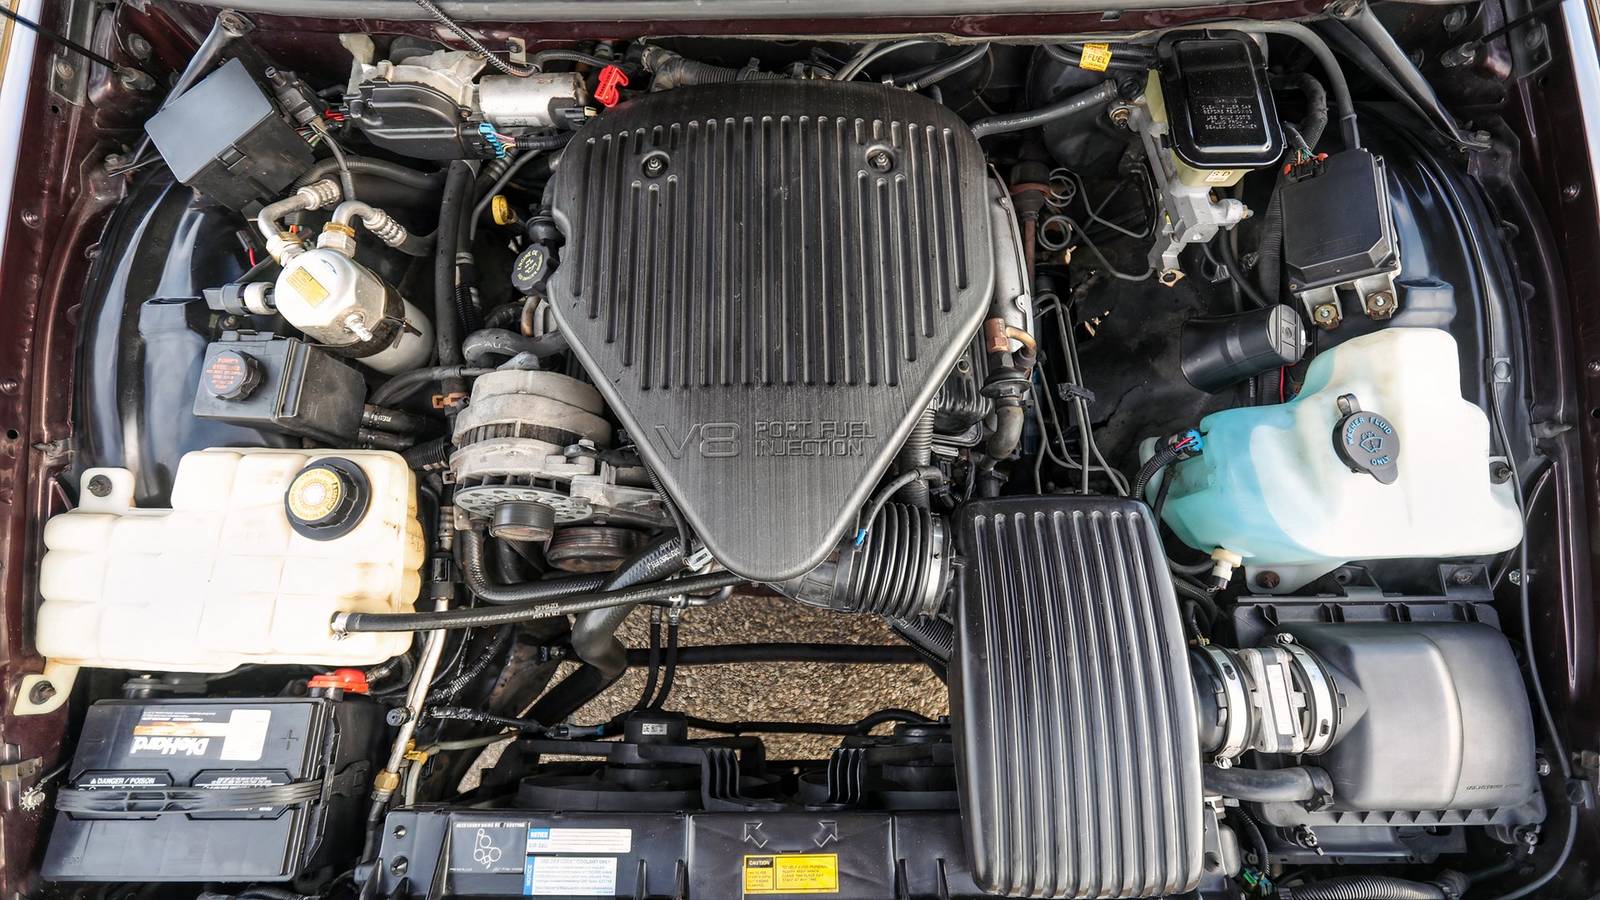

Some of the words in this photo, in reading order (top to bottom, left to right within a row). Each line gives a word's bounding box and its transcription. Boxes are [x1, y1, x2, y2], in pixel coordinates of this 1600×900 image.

[1088, 54, 1106, 63] FUEL
[755, 420, 812, 438] PORT
[820, 420, 875, 439] FUEL
[1346, 416, 1365, 445] WASHER
[1369, 416, 1392, 435] FLUID
[655, 422, 741, 459] V8
[755, 439, 864, 457] INJECTION
[1370, 456, 1392, 466] ONLY
[129, 736, 210, 756] DieHard
